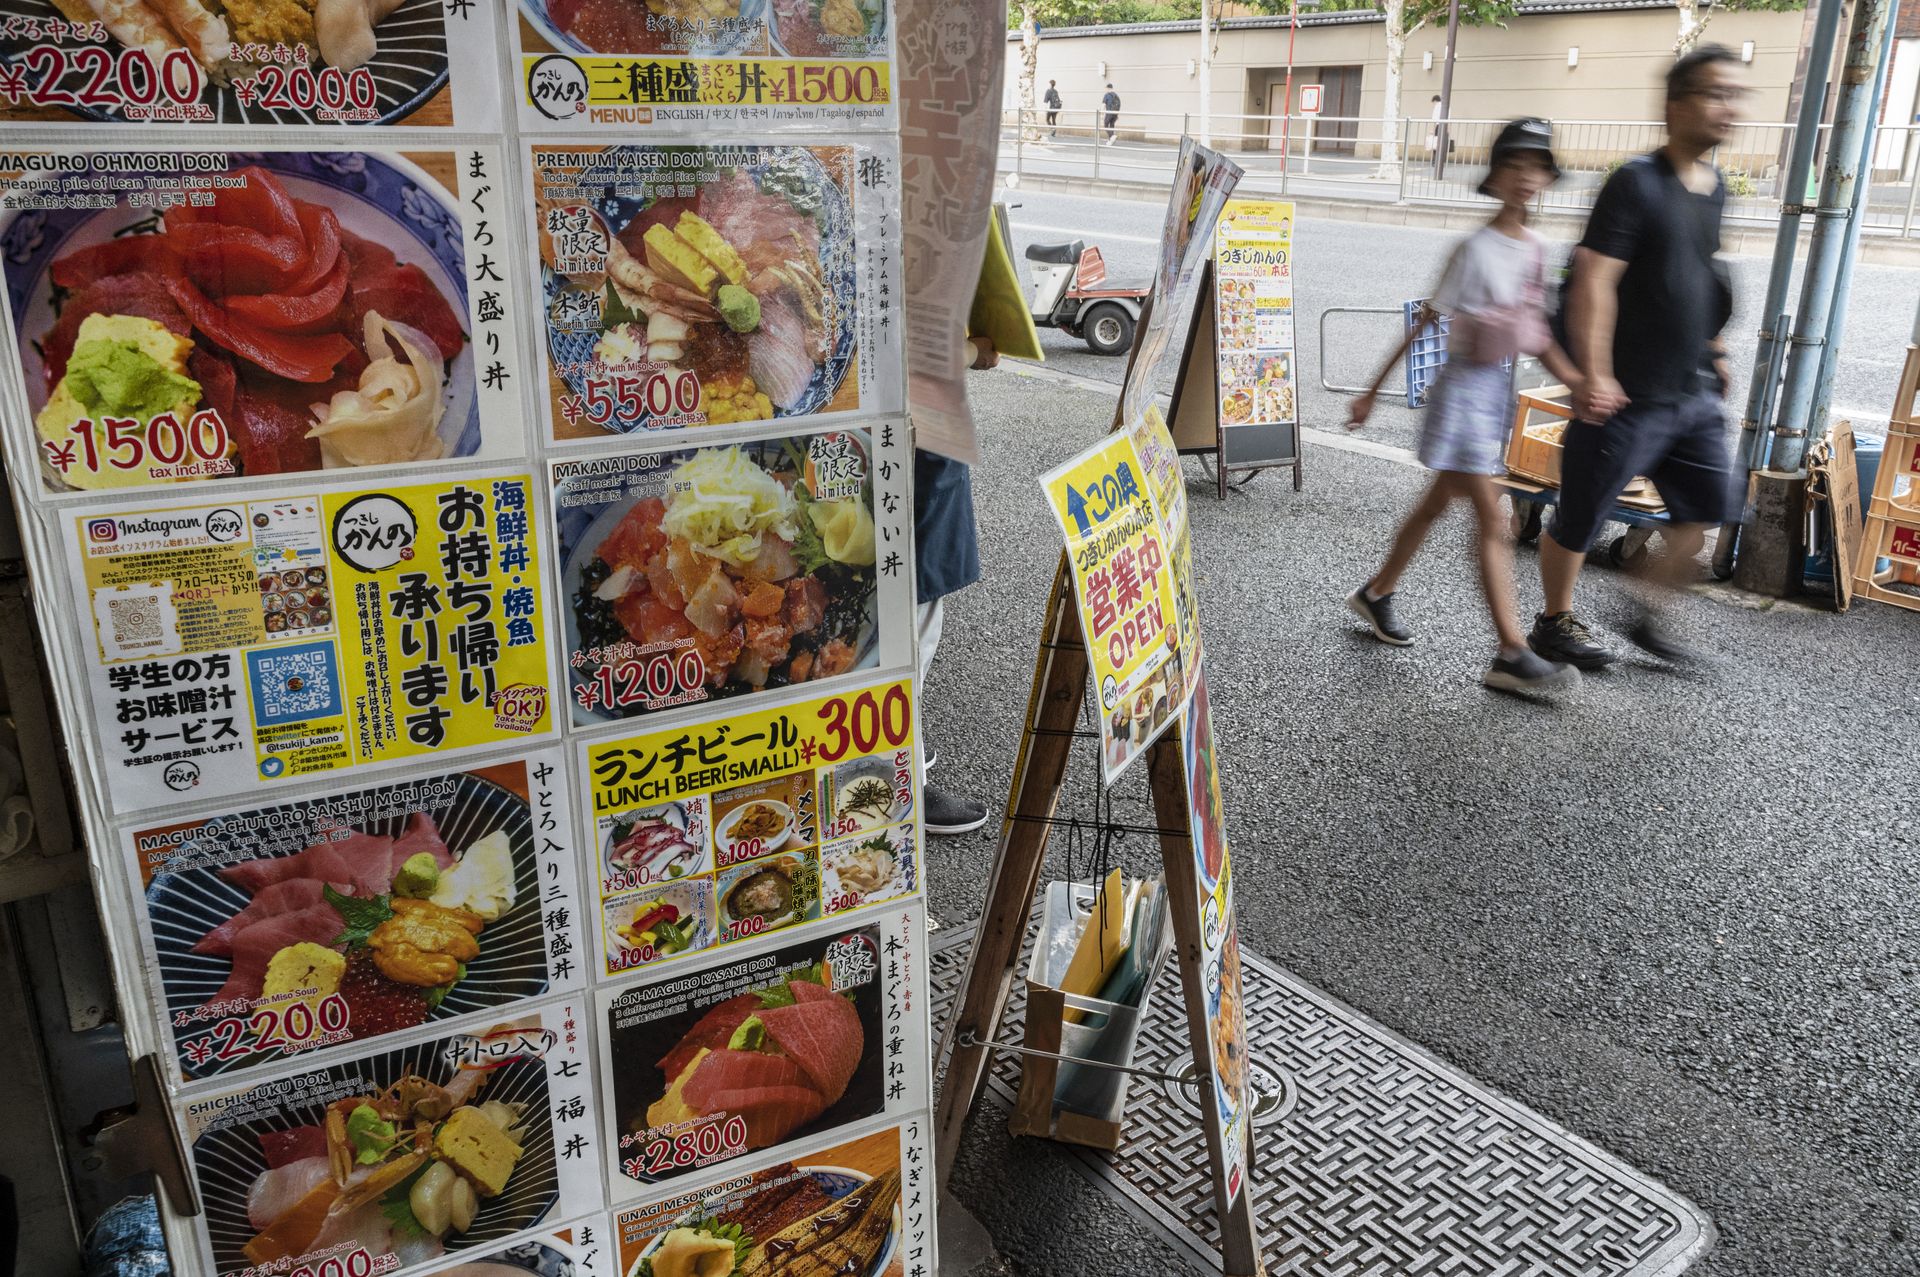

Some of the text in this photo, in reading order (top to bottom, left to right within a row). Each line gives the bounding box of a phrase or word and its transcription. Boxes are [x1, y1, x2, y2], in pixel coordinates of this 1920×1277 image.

[0, 18, 107, 43] ぐろ中とろ
[229, 43, 308, 63] まぐろ赤身
[591, 62, 701, 103] 三種盛
[769, 66, 879, 103] ¥1500
[702, 64, 734, 76] まぐろ
[702, 78, 725, 89] うに
[232, 67, 376, 109] ¥2000
[702, 91, 736, 103] いくら
[125, 105, 214, 120] tax incl.税込
[317, 110, 335, 120] tax
[591, 109, 636, 124] MENU
[656, 109, 705, 120] ENGLISH
[712, 109, 733, 120] 中文
[740, 108, 768, 120] 한국어
[93, 155, 177, 171] OHMORI
[183, 154, 228, 171] DON
[537, 153, 612, 167] PREMIUM
[616, 153, 667, 166] KAISEN
[672, 153, 704, 166] DON
[858, 156, 887, 190] 雅
[1, 175, 247, 193] Heaping pile of Lean Tuna Rice Bowl
[585, 172, 632, 183] Luxurious
[634, 172, 673, 183] Seafood
[677, 172, 695, 182] Rice
[548, 208, 591, 234] 数量
[562, 233, 608, 257] 限定
[1220, 248, 1287, 265] つきじかんの
[469, 151, 511, 392] まぐろ大盛り丼
[556, 257, 604, 273] Limited
[1272, 265, 1289, 277] 本店
[555, 361, 669, 377] みそ汁付 with Miso Soup
[560, 370, 701, 425] ¥5500
[648, 418, 663, 428] tax
[44, 411, 226, 474] ¥1500
[810, 434, 850, 461] 数量
[149, 462, 235, 479] tax incl.税込
[556, 455, 660, 478] MAKANAI DON
[628, 474, 647, 486] Rice
[649, 470, 674, 484] Bowl
[822, 457, 864, 482] 限定
[816, 482, 860, 500] Limited
[878, 425, 904, 578] まかない丼
[1086, 461, 1140, 523] この奥
[118, 517, 201, 537] Instagram
[492, 480, 537, 647] 海鮮丼・焼魚
[437, 486, 500, 709] お持ち帰り
[1086, 532, 1163, 640] 営業中
[1109, 596, 1164, 669] OPEN
[388, 573, 452, 747] 承ります
[571, 642, 635, 667] みそ汁付
[109, 653, 231, 692] 学生の方
[575, 651, 705, 712] ¥1200
[116, 684, 236, 724] お味噌汁
[491, 685, 547, 702] テイクアウト
[496, 714, 534, 727] Take-out
[502, 699, 543, 717] OK!
[121, 716, 240, 754] サービス
[494, 722, 532, 734] available
[801, 684, 911, 765] ¥300
[267, 735, 339, 754] @tsukiji_kanno
[594, 715, 798, 787] ランチビール
[894, 750, 911, 807] とろろ
[596, 780, 670, 812] LUNCH
[140, 782, 457, 851] MAGURO-CHUTORO SANSHU MORI DON
[798, 791, 817, 843] メンマ
[823, 816, 856, 840] ¥150
[717, 837, 762, 866] ¥100
[533, 762, 575, 980] 中とろ入り三種盛丼
[603, 866, 650, 893] ¥500
[824, 891, 860, 915] ¥500
[721, 914, 764, 944] ¥700
[609, 944, 654, 971] ¥100
[611, 955, 777, 1010] HON-MAGURO KASANE DON
[174, 987, 318, 1027] みそ汁付 with Miso Soup
[883, 935, 907, 1101] 本まぐろの重ね丼
[185, 993, 349, 1065] ¥2200
[189, 1072, 329, 1115] SHICHI-HUKU DON
[553, 1061, 589, 1159] 七福丼
[620, 1123, 674, 1148] みそ汁付
[625, 1116, 746, 1178] ¥2800
[621, 1175, 753, 1224] UNAGI MESOKKO DON
[580, 1226, 599, 1277] まぐ
